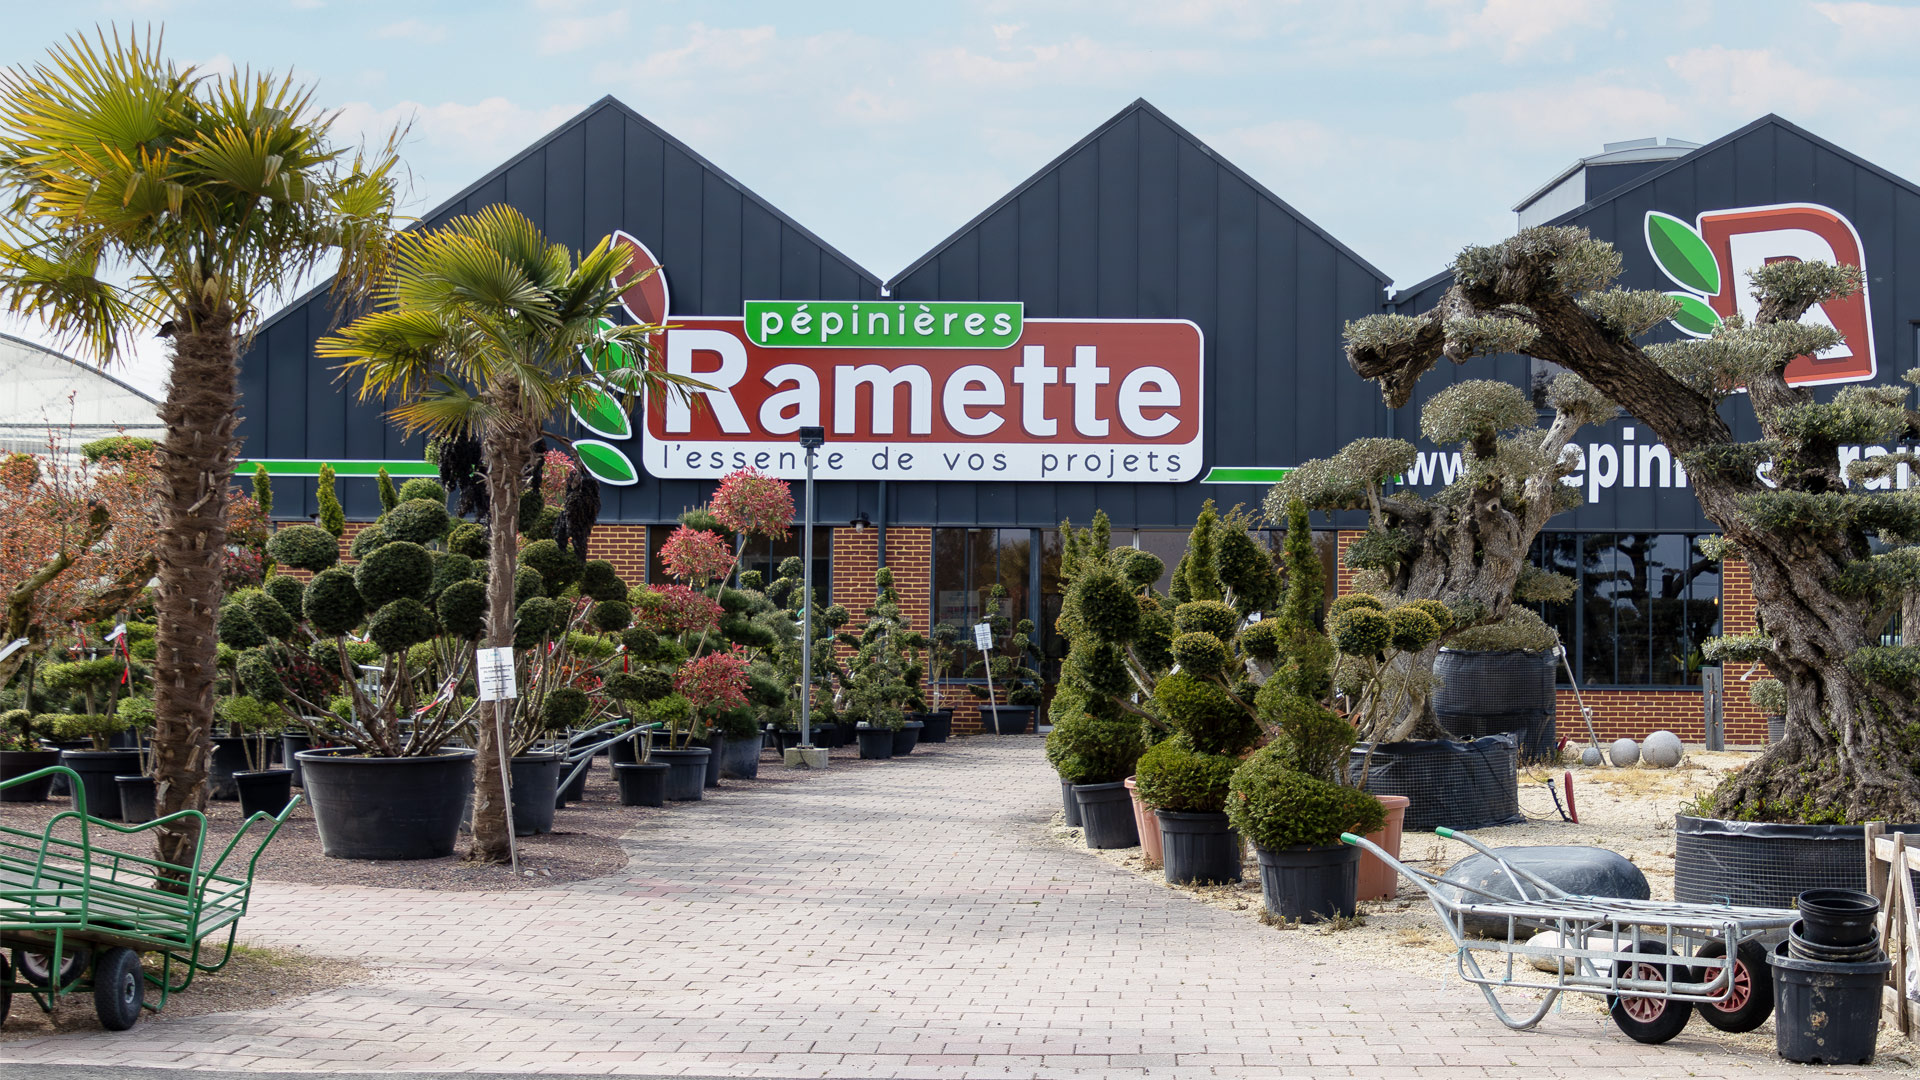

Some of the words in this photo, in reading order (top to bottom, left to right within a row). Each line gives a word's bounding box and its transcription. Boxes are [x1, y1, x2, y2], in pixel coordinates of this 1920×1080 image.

[761, 304, 1012, 343] pépinières
[666, 329, 1181, 437] Ramette
[663, 444, 844, 470] l'essence
[872, 446, 914, 471] de
[943, 452, 1007, 471] vos
[1041, 449, 1181, 478] projets
